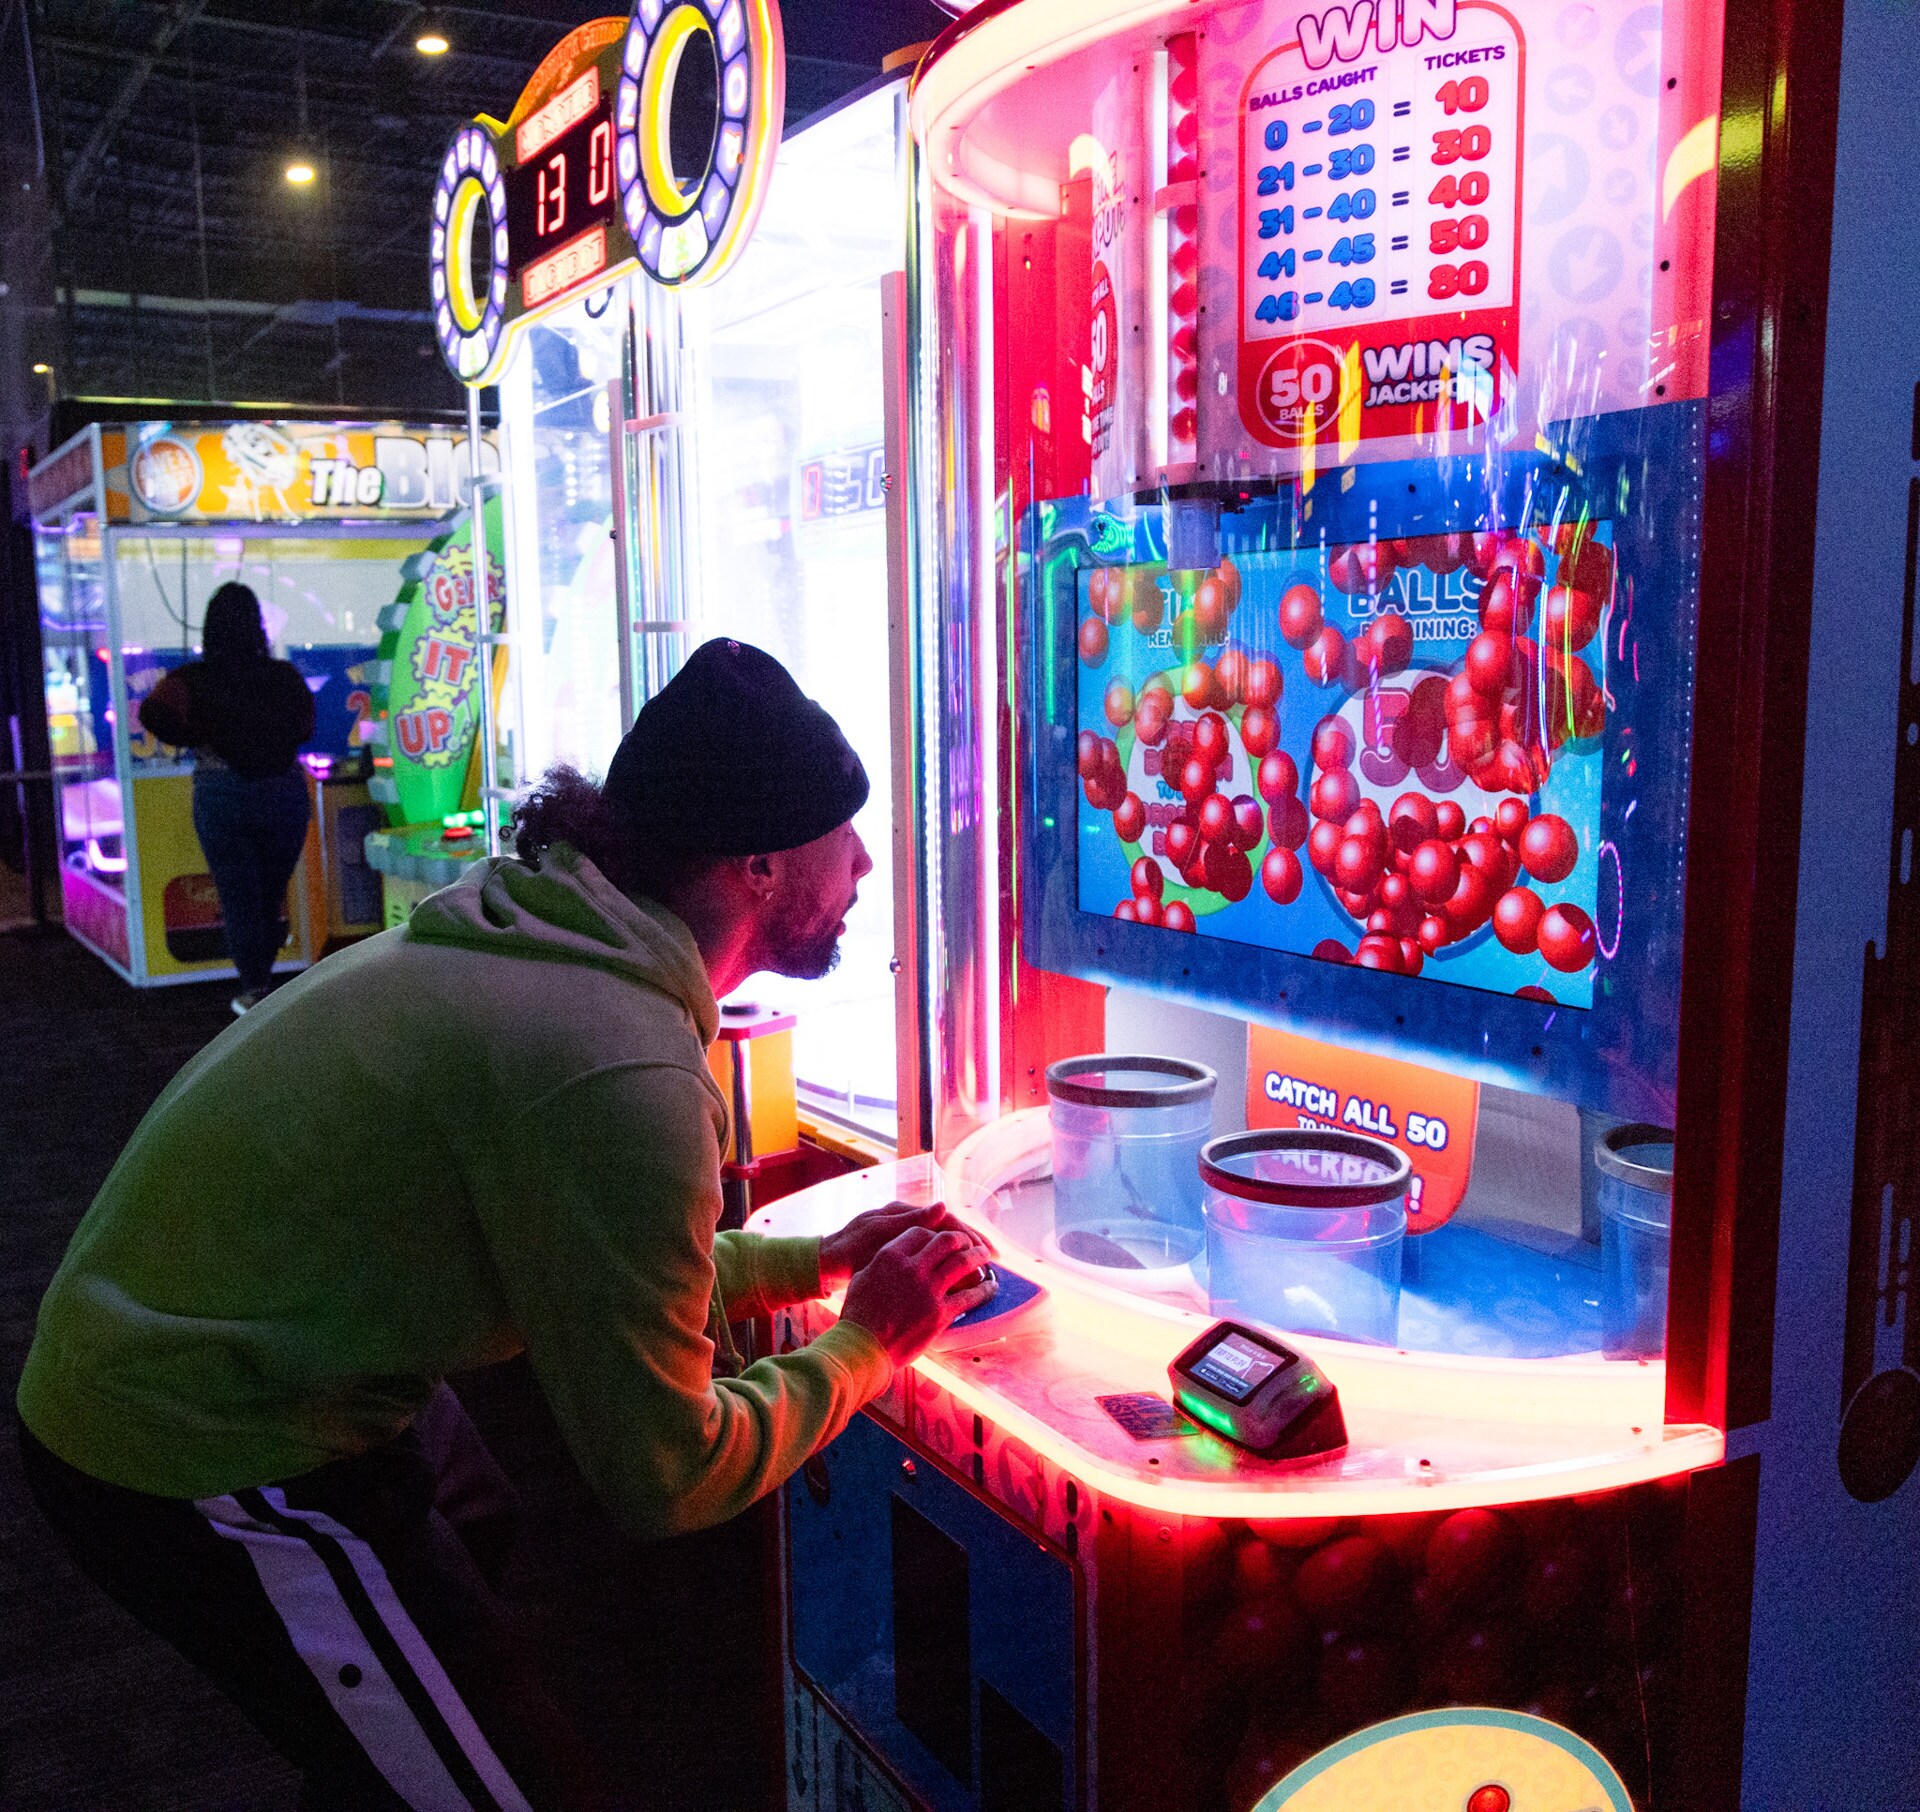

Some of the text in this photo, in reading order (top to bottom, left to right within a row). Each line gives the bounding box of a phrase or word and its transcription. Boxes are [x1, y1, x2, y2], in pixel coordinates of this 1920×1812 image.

[1297, 0, 1457, 71] WIN
[1424, 45, 1505, 70] TICKETS
[1249, 66, 1378, 111] BALLS CAUGHT
[1265, 120, 1287, 150] 0
[1328, 99, 1375, 136] 20
[1436, 76, 1489, 115] 10
[1258, 162, 1295, 196] 21
[1328, 144, 1375, 180] 30
[1431, 125, 1491, 165] 30
[1258, 206, 1295, 239] 31
[1327, 188, 1376, 223] 40
[1429, 172, 1490, 209] 40
[1257, 249, 1295, 280] 41
[1328, 233, 1375, 266] 45
[1429, 214, 1489, 254] 50
[1328, 277, 1375, 310] 49
[1428, 261, 1489, 300] 80
[1363, 334, 1496, 383] WINS
[1269, 363, 1333, 408] 50
[1364, 377, 1480, 408] JACKPO
[311, 459, 383, 506] The
[423, 638, 473, 685] IT
[1265, 1071, 1448, 1151] CATCH ALL 50
